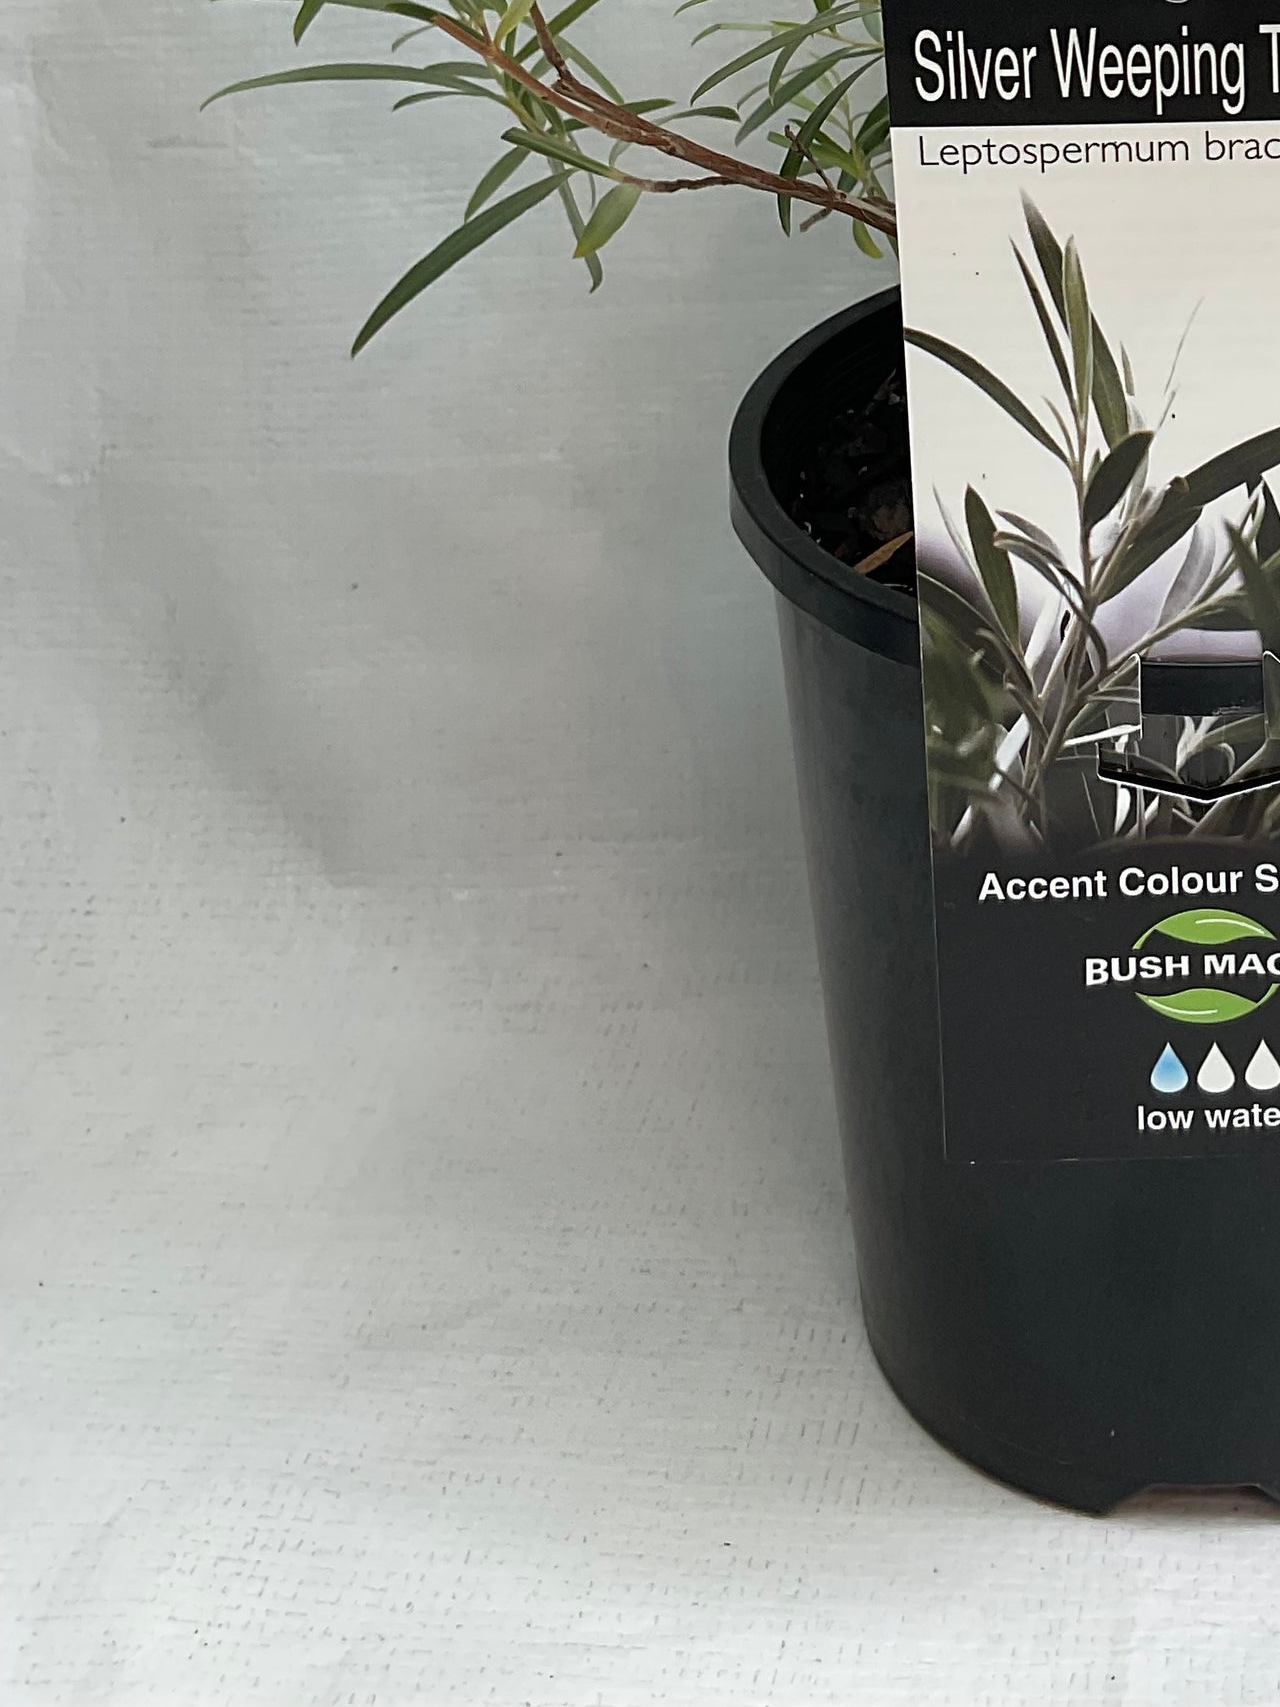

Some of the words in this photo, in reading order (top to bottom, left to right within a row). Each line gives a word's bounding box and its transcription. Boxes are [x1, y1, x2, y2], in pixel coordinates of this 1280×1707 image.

[914, 29, 1037, 101] Silver
[1050, 25, 1245, 115] Weeping
[918, 134, 1190, 174] Leptospermum
[978, 869, 1107, 902] Accent
[1118, 866, 1243, 897] Colour
[1084, 953, 1190, 987] BUSH
[1136, 1105, 1195, 1132] low
